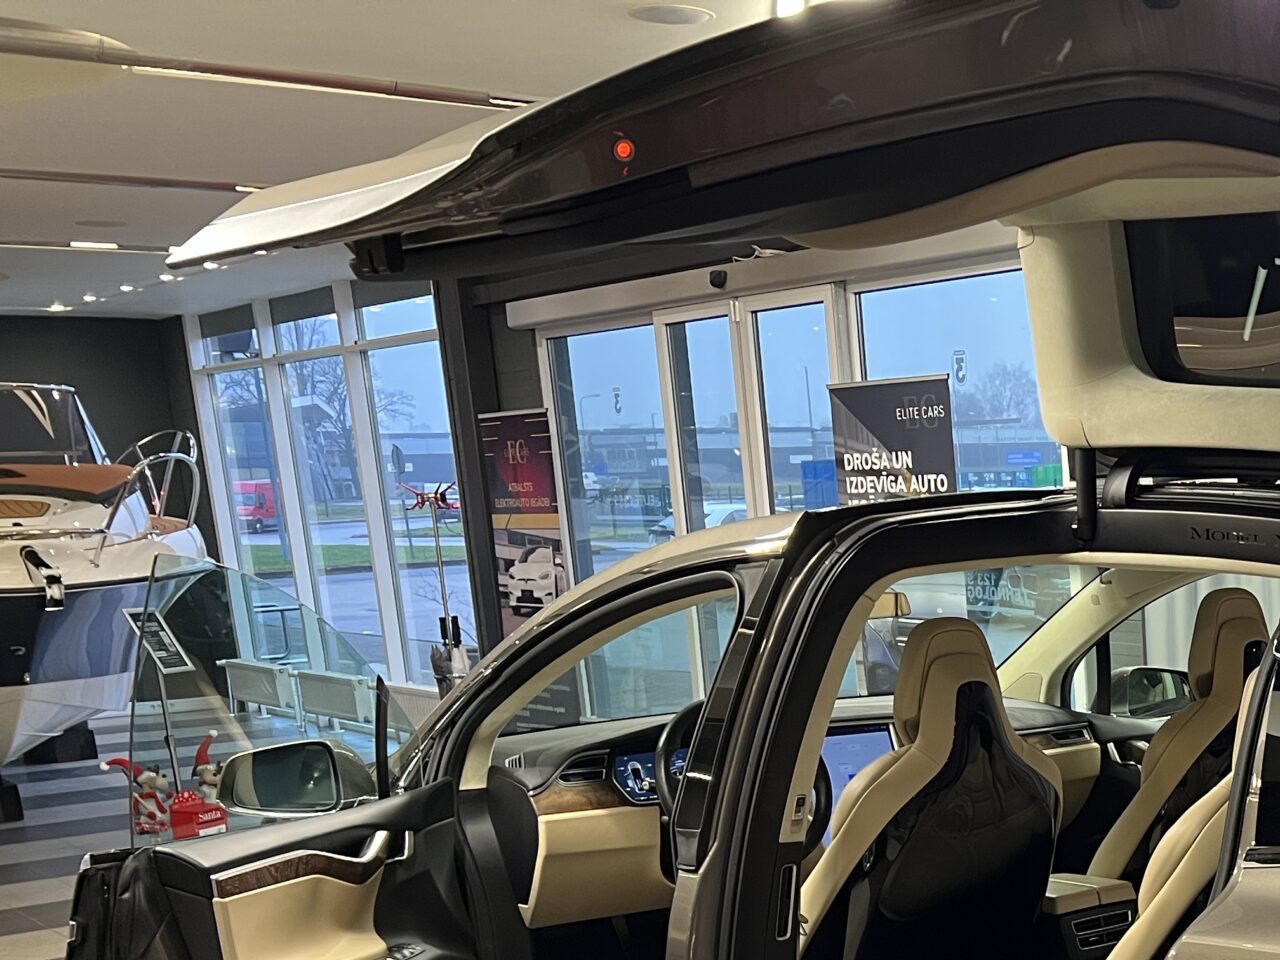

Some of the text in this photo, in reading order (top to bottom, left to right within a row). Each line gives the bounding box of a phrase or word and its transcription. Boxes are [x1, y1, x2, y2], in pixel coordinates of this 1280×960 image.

[896, 405, 945, 420] ELITE CARS
[843, 448, 913, 471] DROŠA UN
[845, 471, 907, 494] IZDEVĪGA
[910, 473, 948, 492] AUTO
[198, 810, 221, 822] Santa
